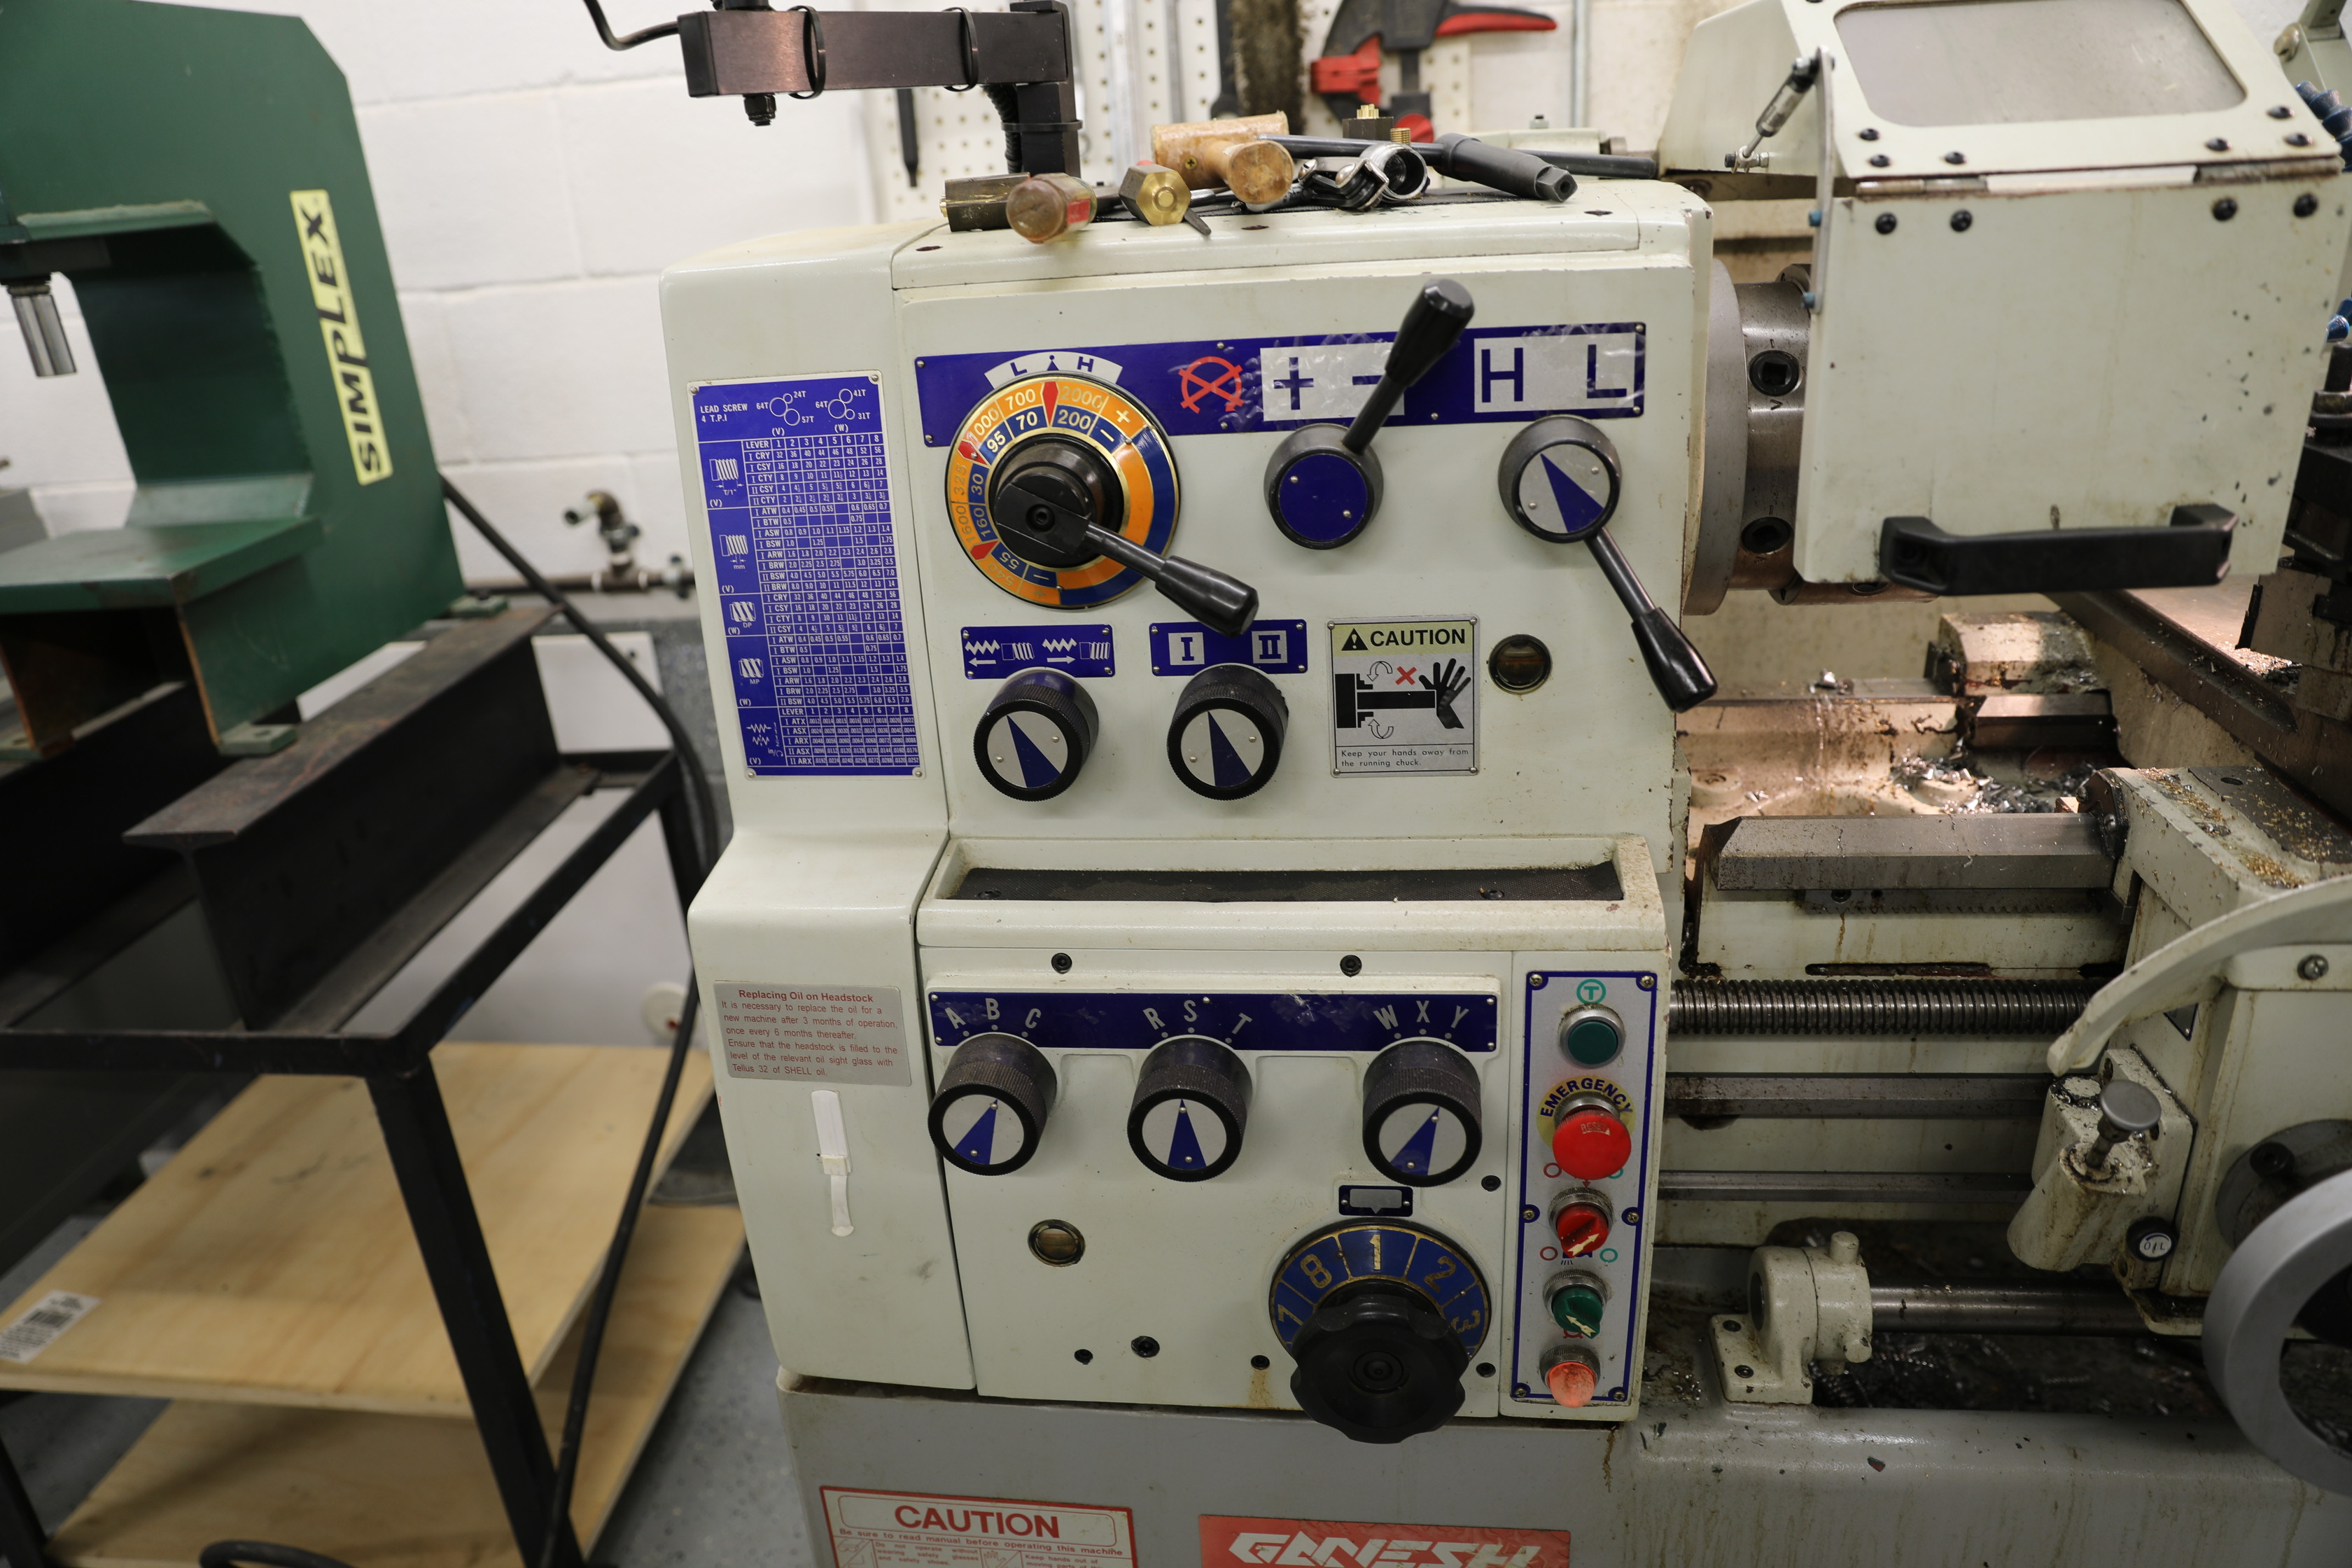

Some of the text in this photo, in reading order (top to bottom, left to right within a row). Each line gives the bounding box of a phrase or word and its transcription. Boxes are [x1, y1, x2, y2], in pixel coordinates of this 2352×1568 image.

[300, 205, 381, 473] SIMPLEX
[1010, 356, 1093, 376] L H
[1481, 344, 1627, 402] H L
[815, 400, 828, 409] 64T
[1005, 388, 1036, 410] 700
[1060, 386, 1105, 408] 2000
[700, 403, 748, 414] LEAD SCREW
[858, 412, 871, 420] 31T
[834, 424, 849, 433] (W)
[967, 407, 999, 443] 1000
[1015, 412, 1037, 430] 70
[1058, 410, 1091, 430] 200
[771, 427, 785, 437] (V)
[986, 430, 1006, 453] 95
[746, 441, 769, 449] LEVER
[953, 463, 967, 496] 325
[972, 473, 984, 495] 30
[956, 505, 976, 543] 1600
[974, 507, 991, 538] 160
[1000, 552, 1020, 570] 55
[987, 563, 1014, 587] 540
[1181, 634, 1282, 661] I II
[1371, 629, 1465, 647] CAUTION
[738, 990, 787, 1001] Replacing
[790, 991, 804, 1000] Oil
[821, 993, 874, 1002] Headstock
[742, 1002, 781, 1012] necessary
[798, 1004, 827, 1013] replace
[848, 1005, 857, 1014] oil
[944, 998, 1042, 1029] A B C
[1142, 1000, 1253, 1035] R S T
[1373, 1000, 1469, 1030] W X Y
[744, 1015, 777, 1023] machine
[803, 1016, 808, 1025] 3
[813, 1018, 841, 1026] months
[749, 1028, 770, 1037] every
[774, 1028, 780, 1036] 6
[784, 1029, 813, 1037] months
[817, 1030, 856, 1039] thereafter.
[728, 1039, 755, 1047] Ensure
[760, 1040, 774, 1049] that
[795, 1042, 834, 1051] headstock
[850, 1044, 868, 1053] filled
[885, 1046, 898, 1054] the
[730, 1051, 748, 1060] level
[764, 1053, 776, 1061] the
[780, 1054, 812, 1063] relevant
[829, 1056, 848, 1065] sight
[852, 1057, 873, 1067] glass
[732, 1064, 755, 1072] Tellus
[773, 1065, 780, 1074] of
[785, 1066, 812, 1075] SHELL
[1540, 1077, 1634, 1117] EMERGENCY
[1581, 1123, 1608, 1132] RESET
[1369, 1235, 1381, 1270] 1
[2143, 1242, 2166, 1254] OIL
[1300, 1254, 1331, 1289] 8
[1424, 1256, 1457, 1292] 2
[1278, 1304, 1305, 1326] 7
[1450, 1310, 1481, 1334] 3
[895, 1505, 1060, 1538] CAUTION
[926, 1536, 960, 1544] manual
[966, 1538, 998, 1547] before
[1004, 1541, 1051, 1551] operating
[1081, 1547, 1123, 1555] machine
